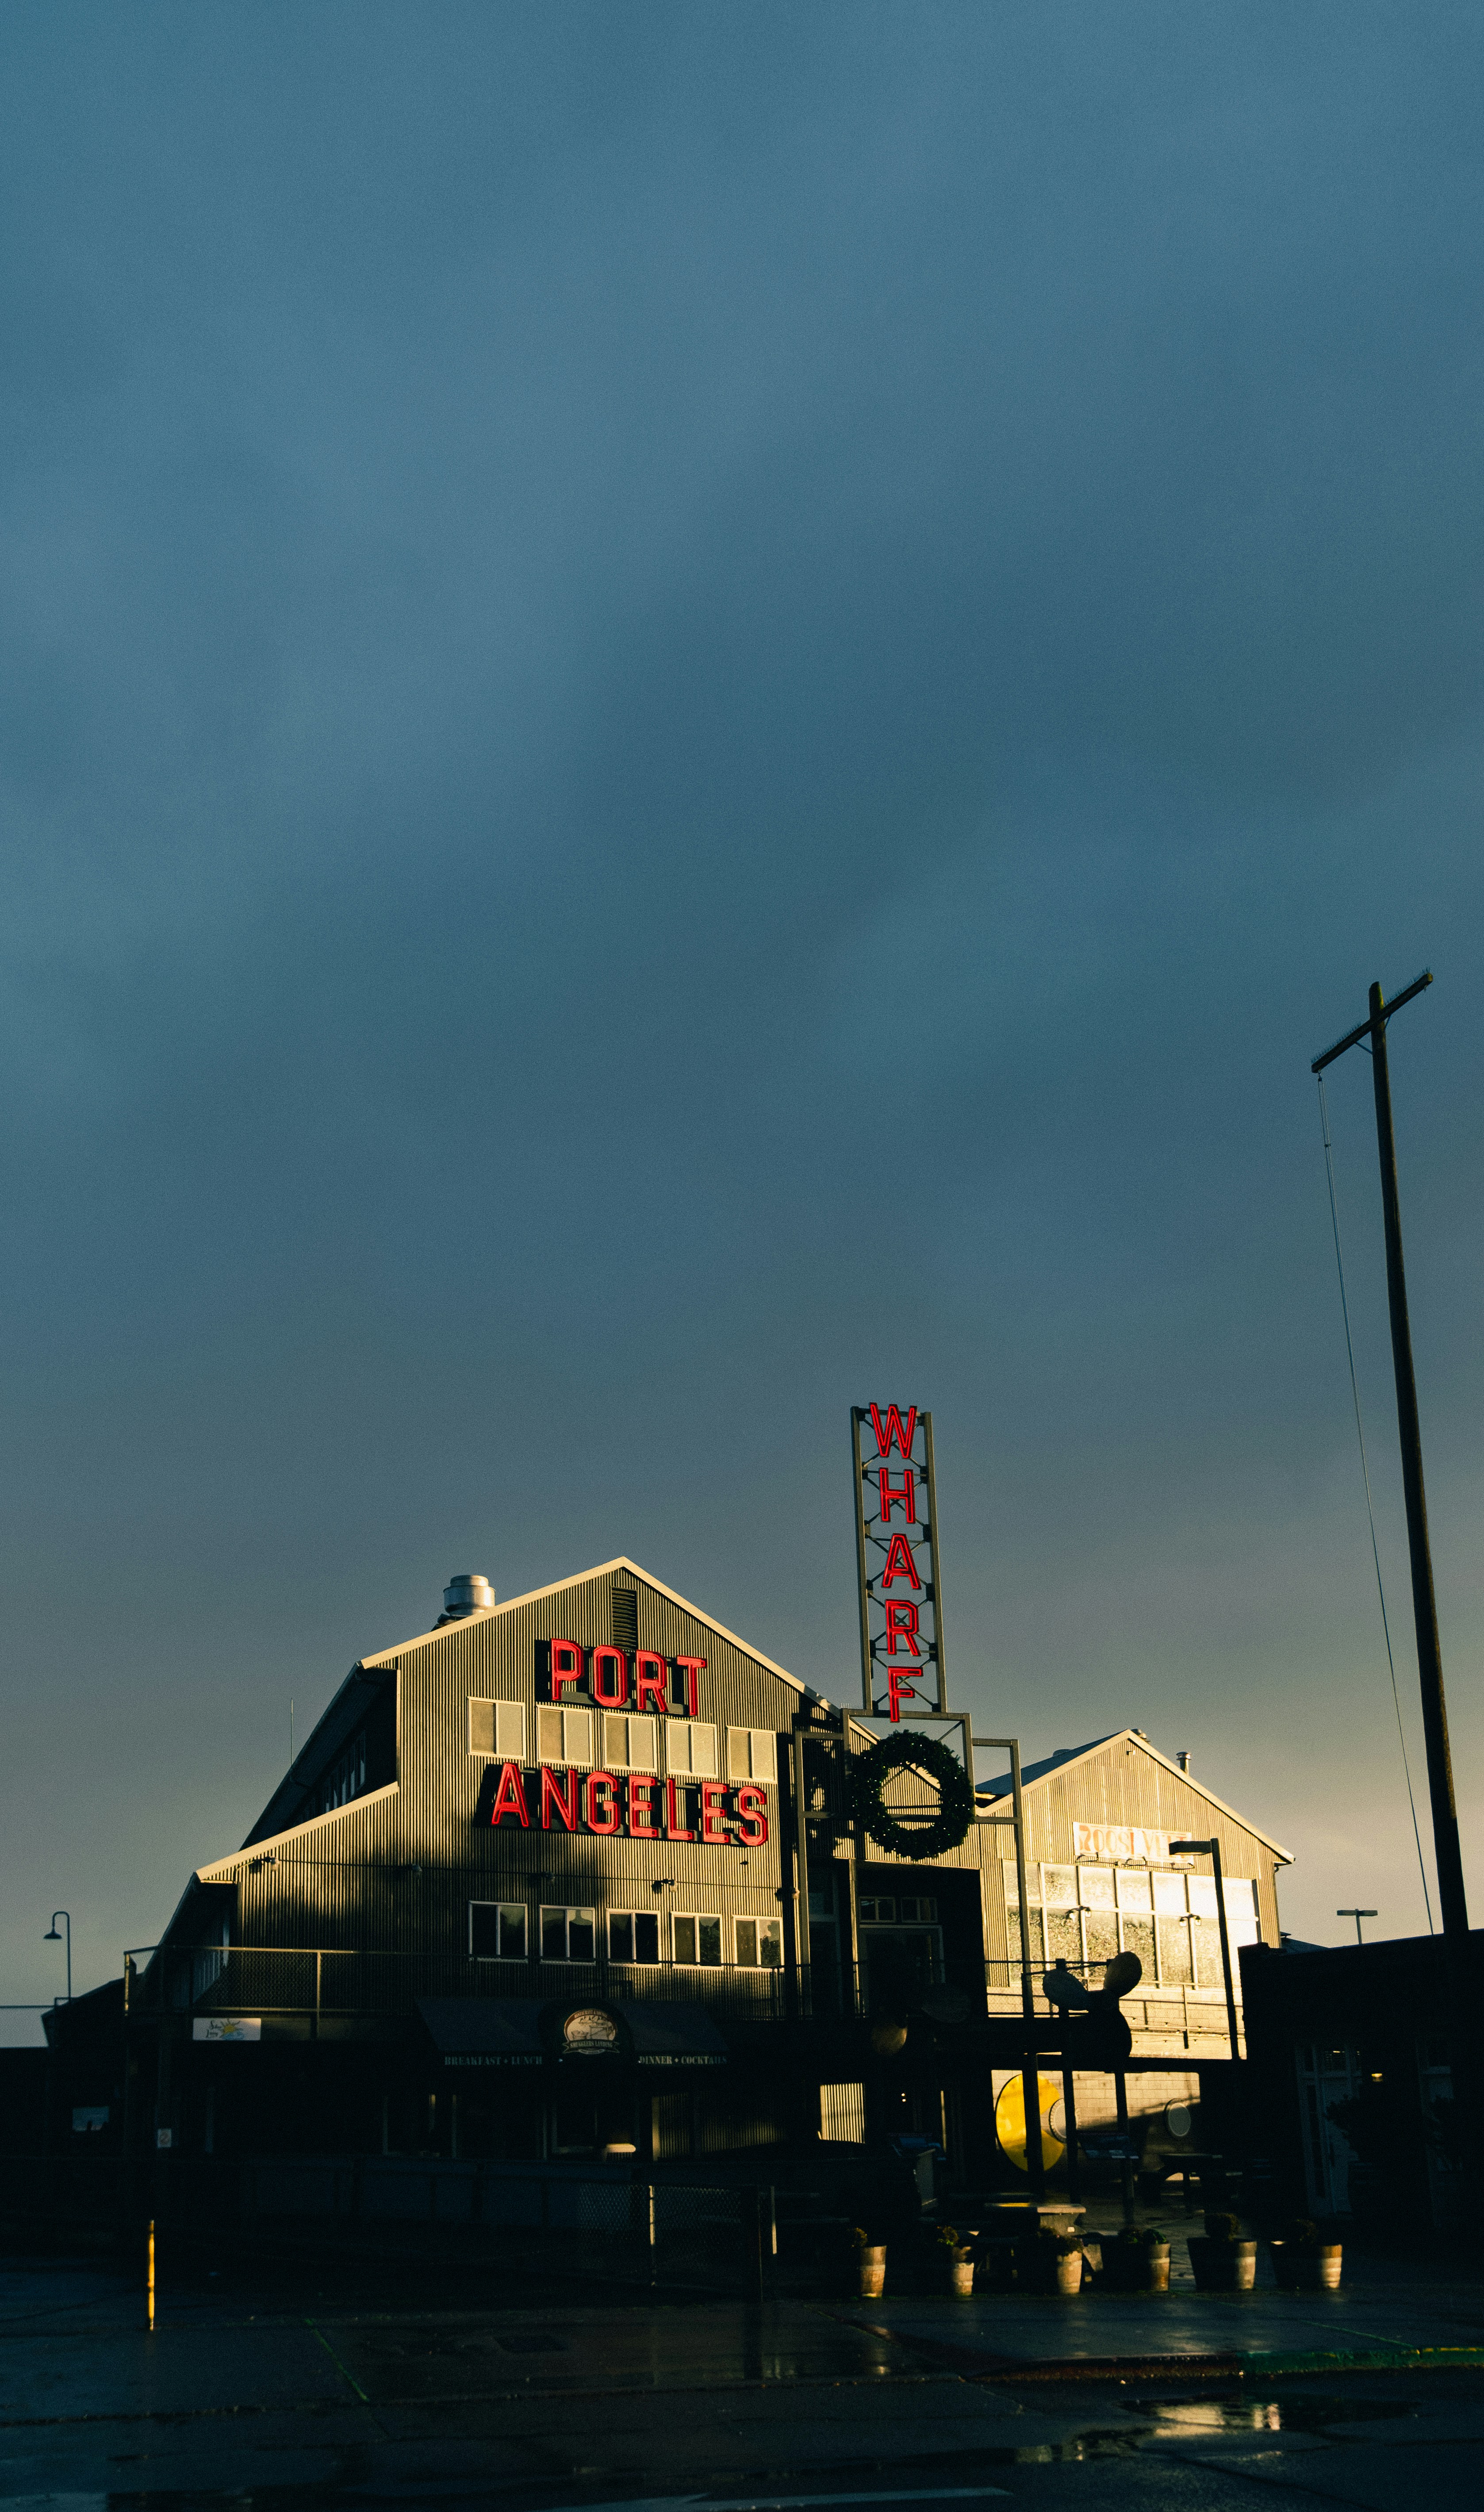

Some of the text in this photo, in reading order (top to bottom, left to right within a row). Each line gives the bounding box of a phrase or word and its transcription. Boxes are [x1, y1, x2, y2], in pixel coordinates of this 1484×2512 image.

[870, 1402, 924, 1723] WHARF
[550, 1637, 708, 1716] PORT
[491, 1762, 768, 1846] ANGELES
[444, 2056, 543, 2066] BREAKFAST LUNCH
[639, 2055, 728, 2065] DINNER COCKTAILS
